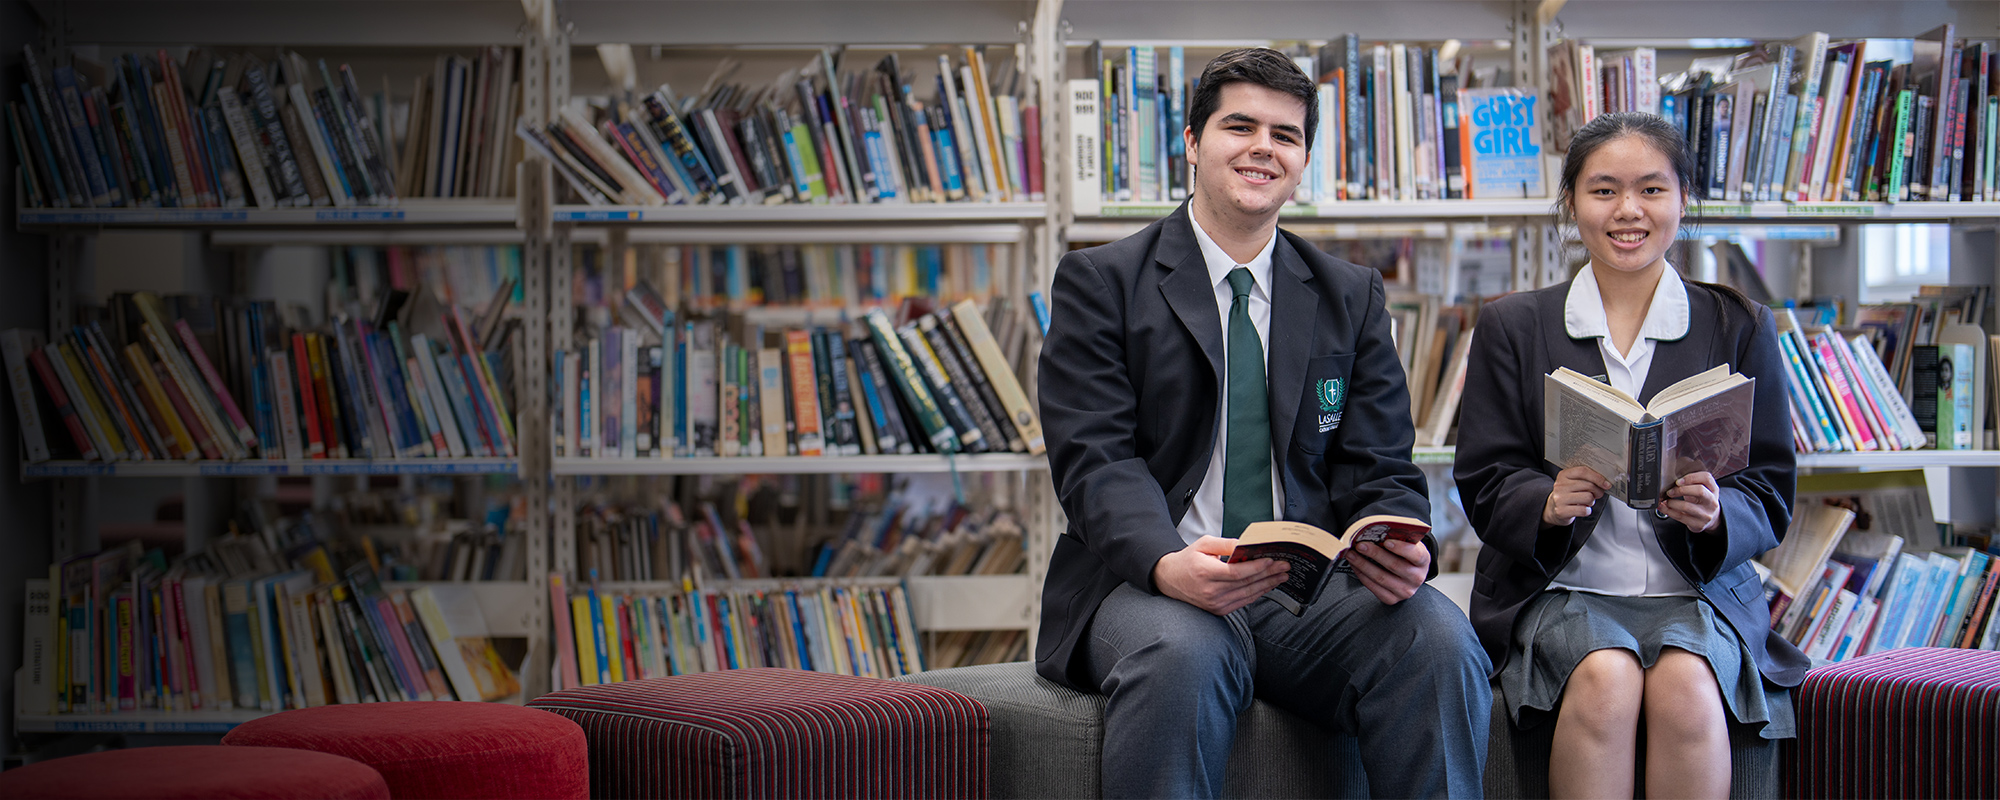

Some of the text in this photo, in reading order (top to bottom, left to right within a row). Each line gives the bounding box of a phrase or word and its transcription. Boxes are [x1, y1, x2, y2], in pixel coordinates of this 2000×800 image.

[1473, 95, 1537, 127] GUTSY
[1474, 127, 1539, 154] GIRL
[1954, 111, 1965, 148] MAUS
[33, 637, 43, 685] LITERATURE
